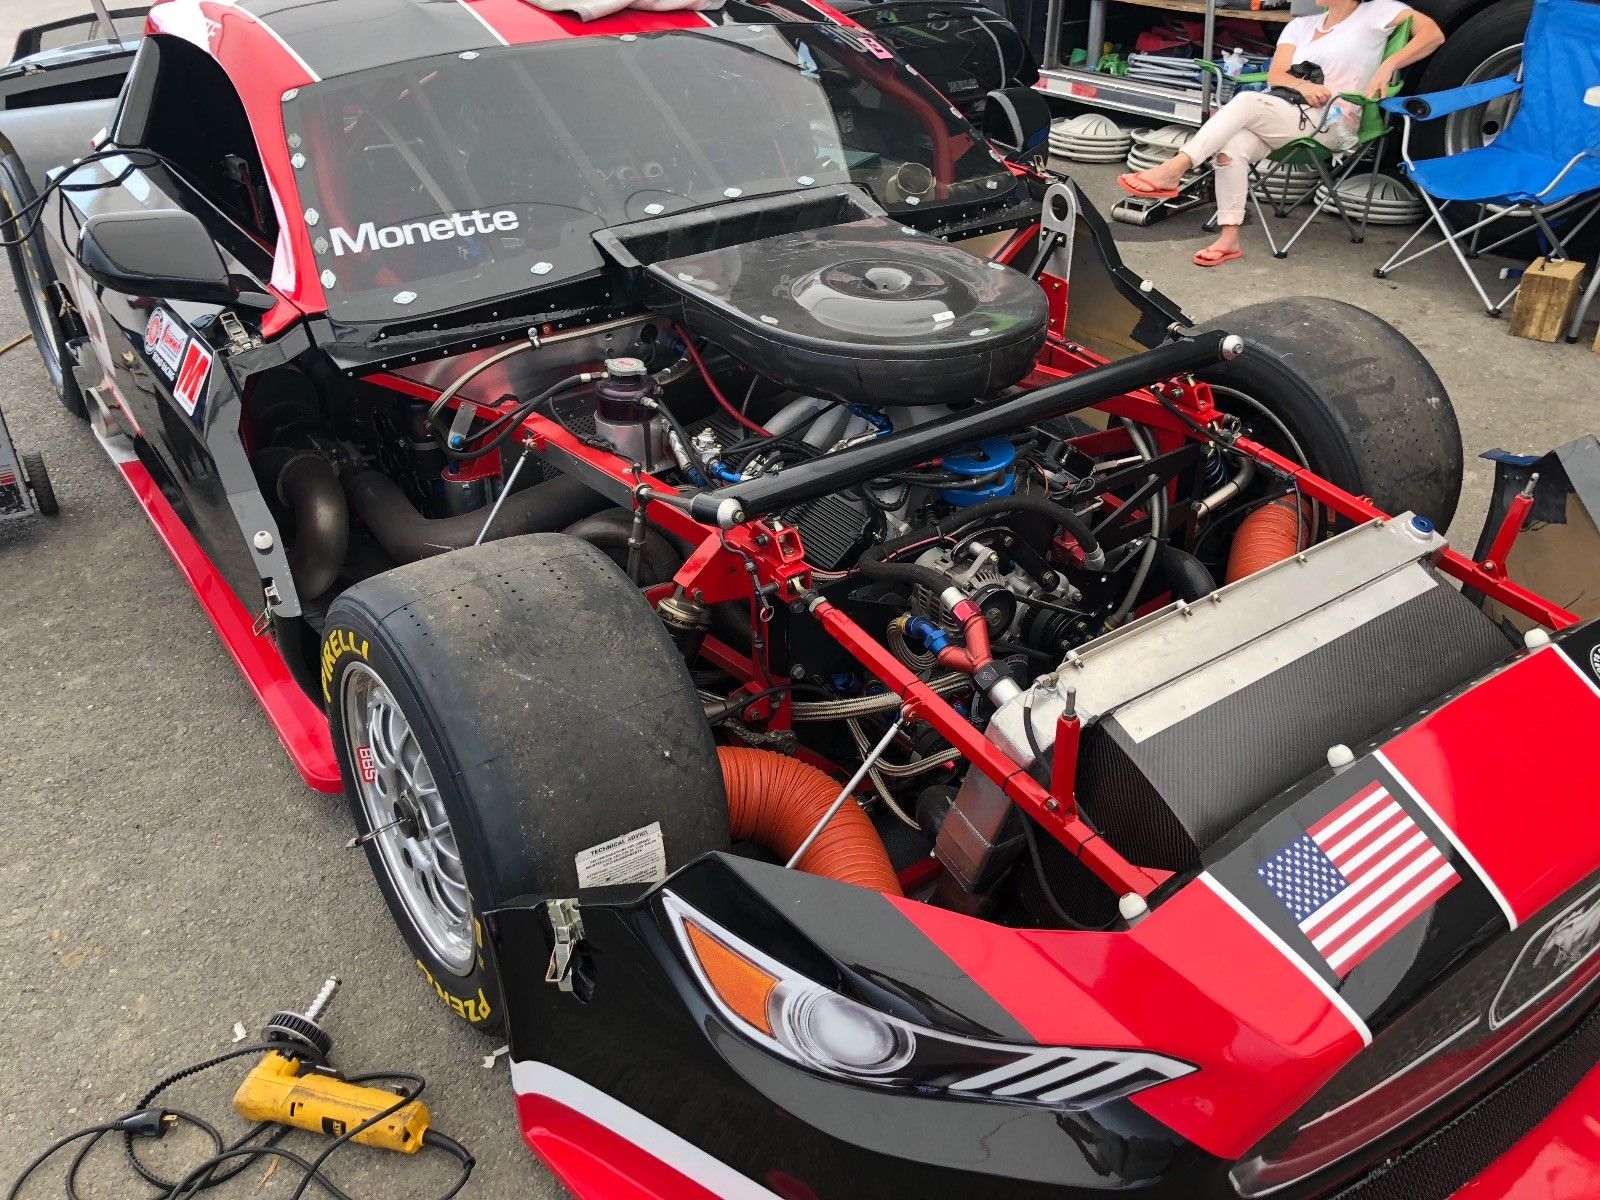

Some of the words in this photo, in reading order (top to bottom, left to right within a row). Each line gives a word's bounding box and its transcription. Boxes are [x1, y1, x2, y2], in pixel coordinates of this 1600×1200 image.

[329, 209, 519, 257] Monette
[321, 629, 369, 704] PIRELLI
[359, 747, 376, 780] BBS
[590, 839, 626, 856] TECHNICAL
